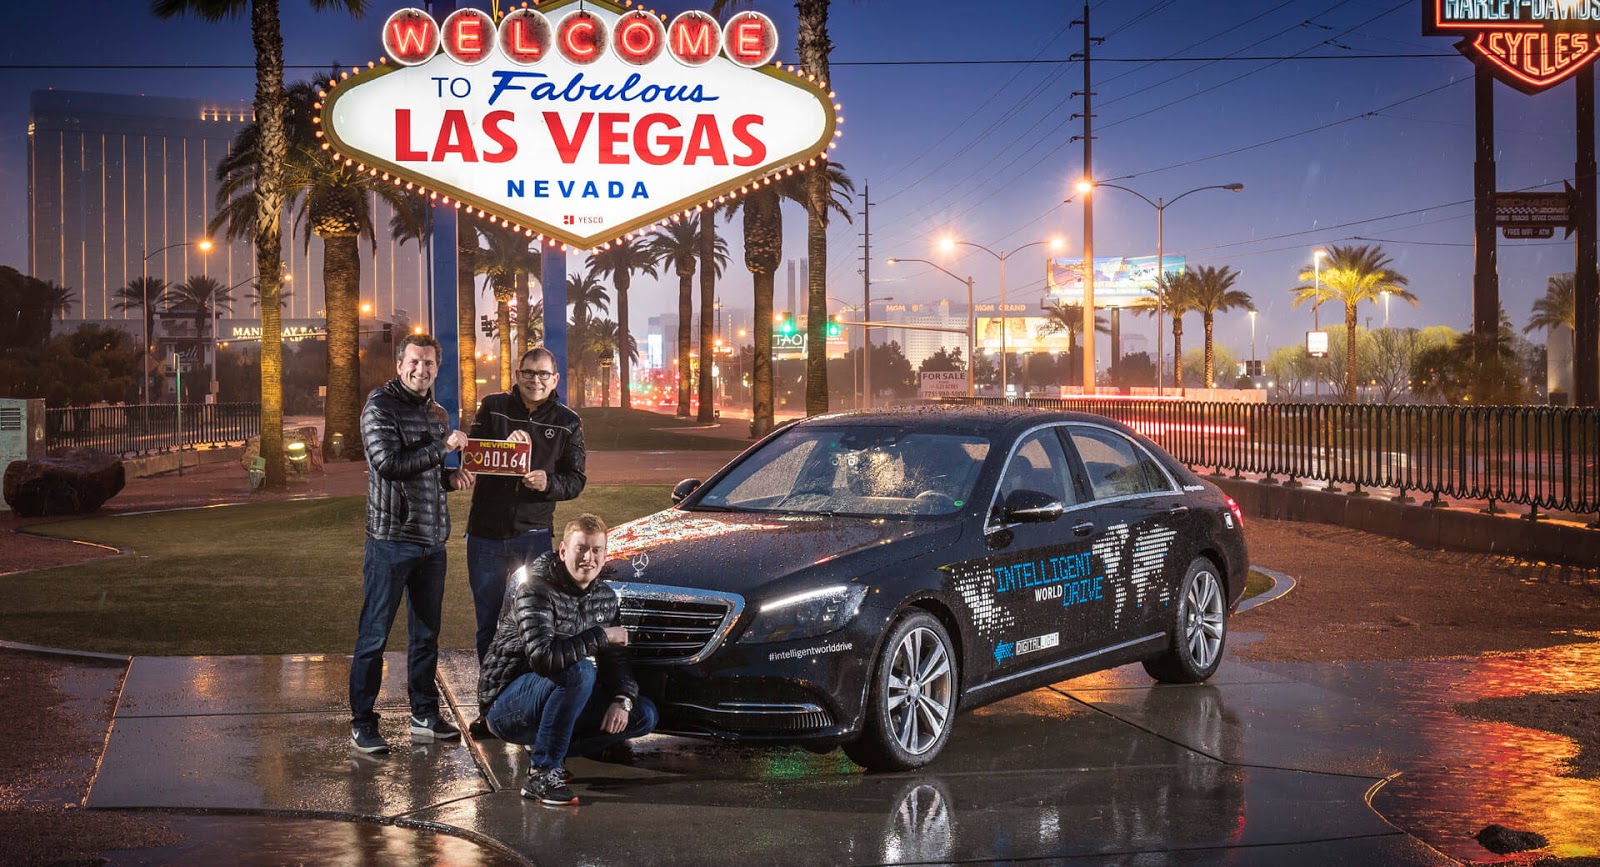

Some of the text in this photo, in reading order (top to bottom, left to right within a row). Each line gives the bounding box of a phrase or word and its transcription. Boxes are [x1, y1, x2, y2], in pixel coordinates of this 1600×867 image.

[390, 18, 764, 59] WELCOME
[1489, 32, 1588, 76] CYCLES
[431, 70, 719, 106] TO Fabulous
[395, 109, 767, 166] LAS VEGAS
[507, 180, 650, 199] NEVADA
[578, 216, 604, 225] YESCO
[975, 304, 994, 312] MGM
[773, 334, 803, 346] TAO
[480, 441, 516, 449] NEVADA
[994, 551, 1092, 593] INTELLIGENT
[1034, 576, 1104, 607] WORLD DRIVE
[768, 641, 854, 661] #intelligentworlddrive
